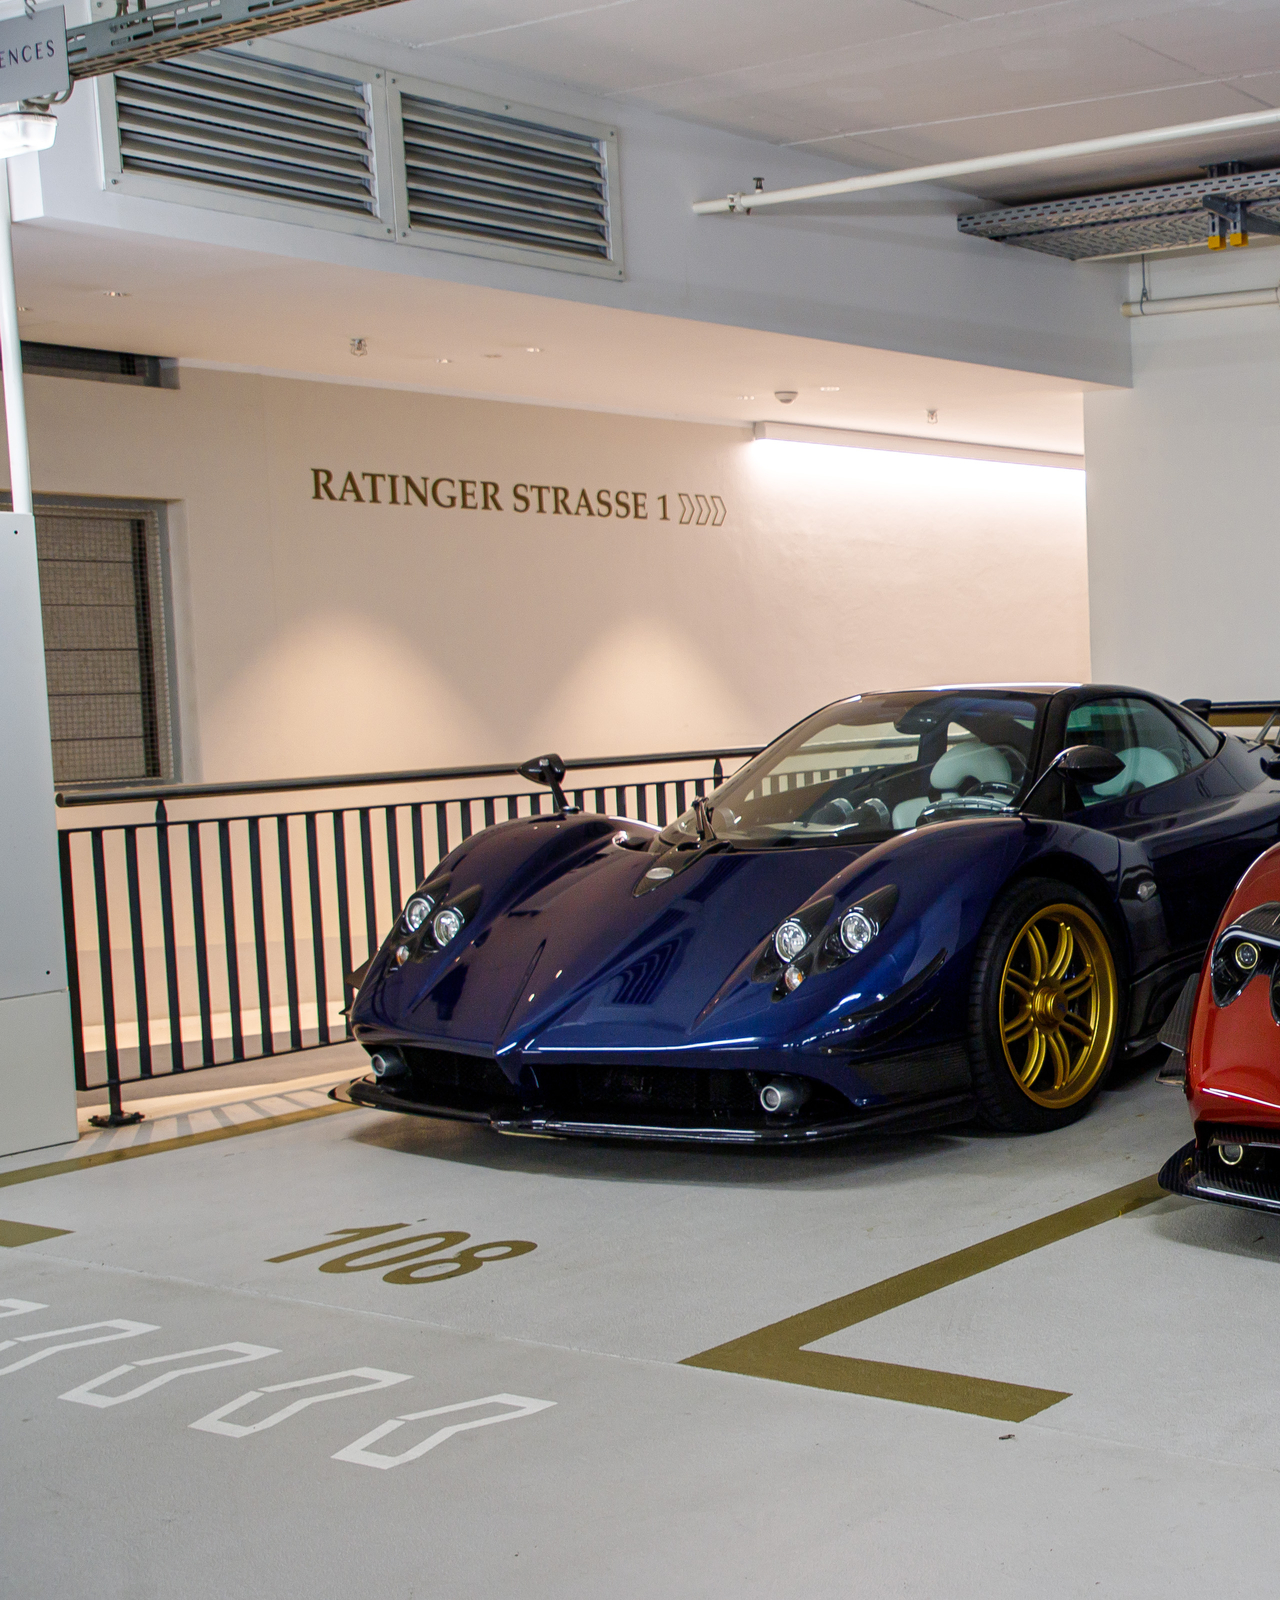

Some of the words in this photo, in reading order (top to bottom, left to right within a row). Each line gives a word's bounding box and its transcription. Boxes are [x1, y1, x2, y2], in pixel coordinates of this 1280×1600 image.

[310, 467, 504, 513] RATINGER
[512, 483, 648, 520] STRASSE
[657, 494, 670, 521] 1
[266, 1223, 538, 1285] 108
